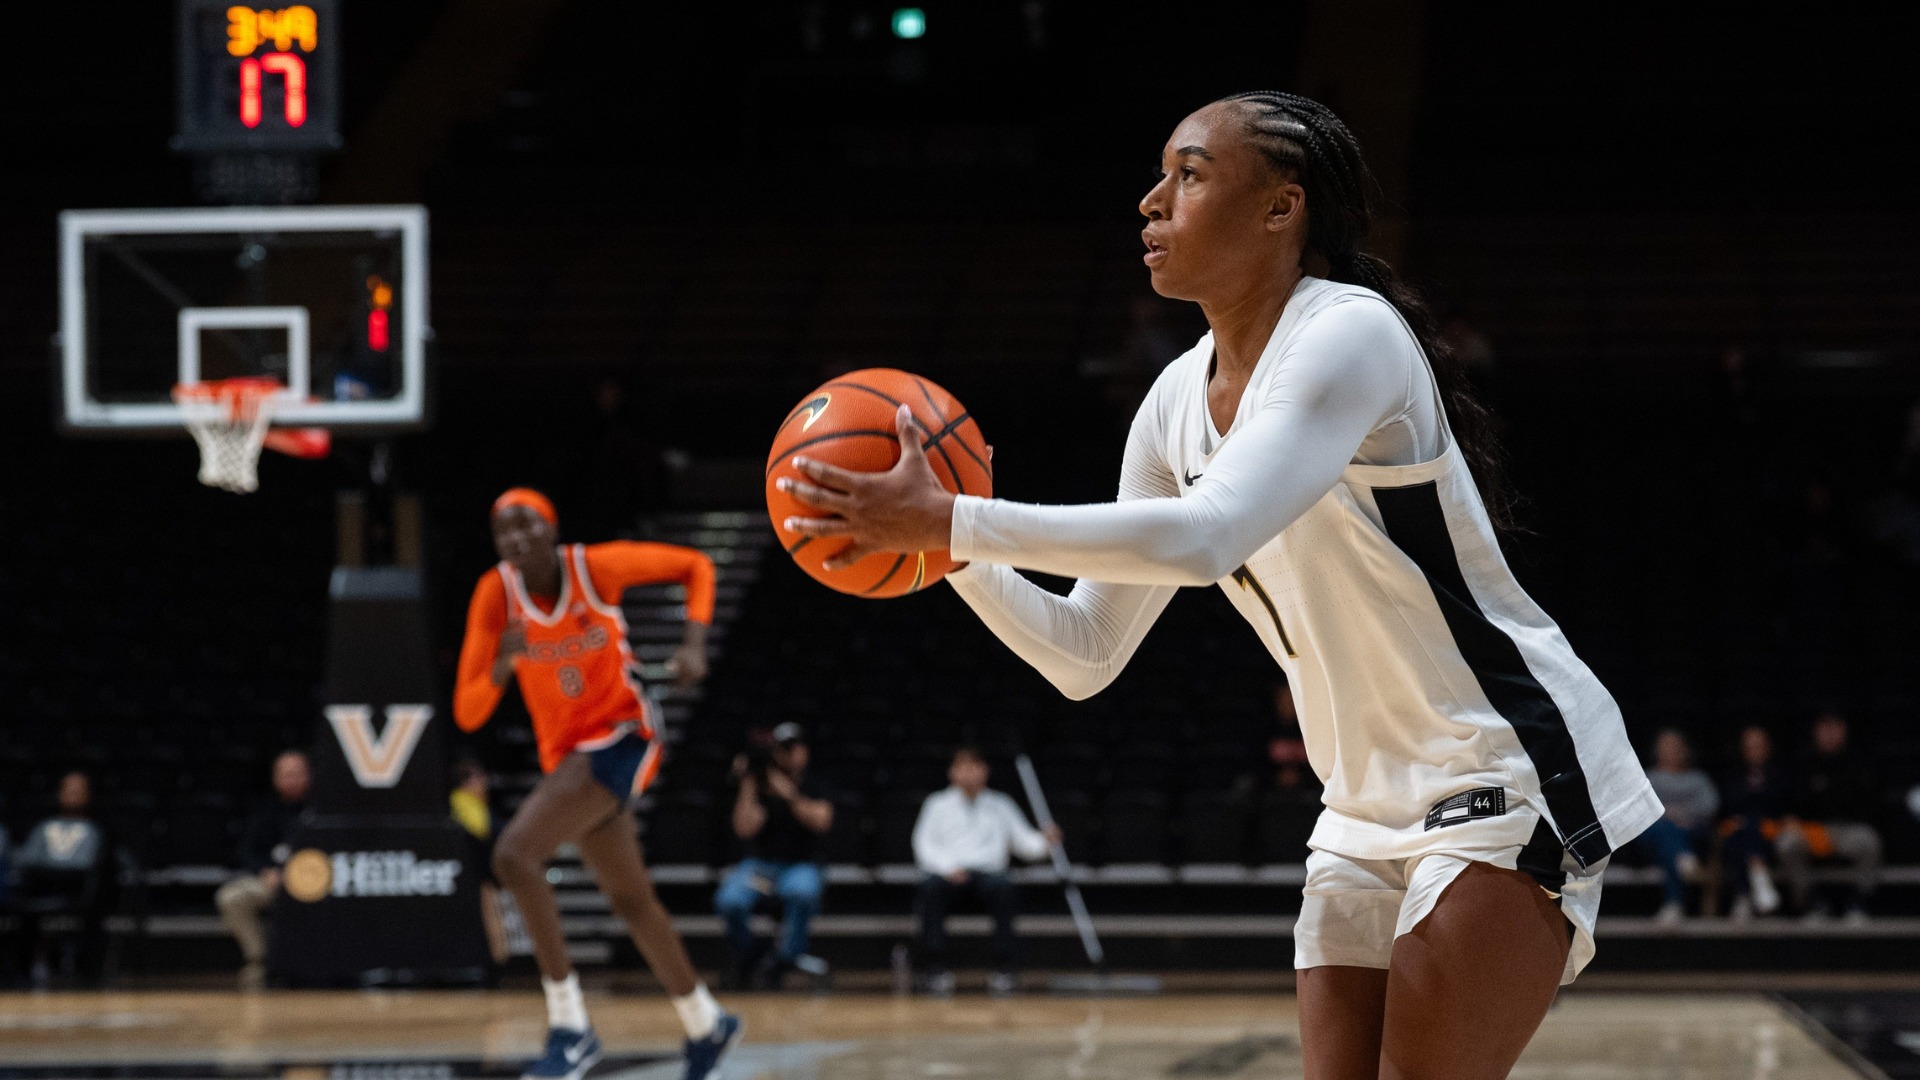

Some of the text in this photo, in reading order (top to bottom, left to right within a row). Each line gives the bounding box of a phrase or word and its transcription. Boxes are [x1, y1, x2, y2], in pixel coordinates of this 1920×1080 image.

[240, 52, 307, 128] 17
[323, 703, 434, 789] V
[1474, 797, 1490, 809] 44
